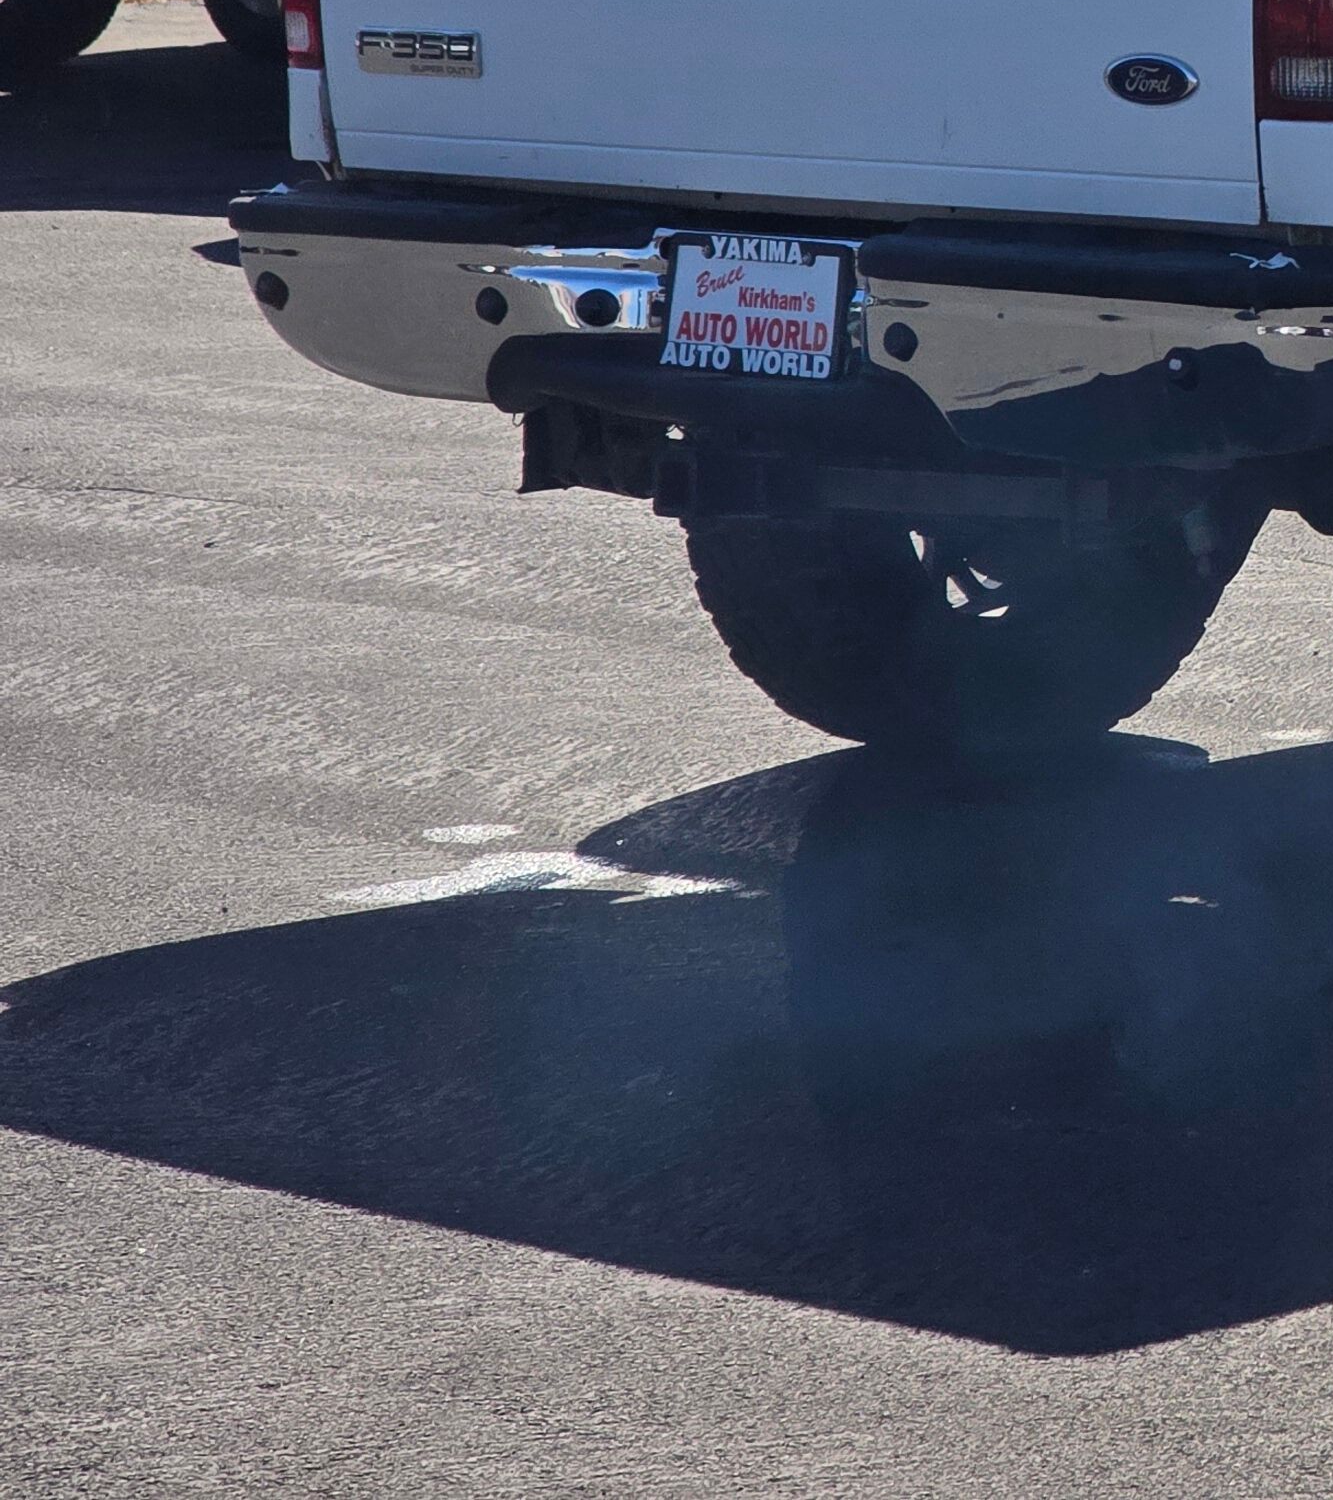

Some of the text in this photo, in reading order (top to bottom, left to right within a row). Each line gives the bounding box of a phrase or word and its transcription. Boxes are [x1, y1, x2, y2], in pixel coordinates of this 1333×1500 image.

[1125, 65, 1171, 92] Ford
[711, 235, 803, 264] YAKIMA
[696, 265, 745, 298] Bruce
[738, 286, 815, 313] Kirkham's
[676, 311, 828, 352] AUTO WORLD
[660, 341, 831, 379] AUTO WORLD
